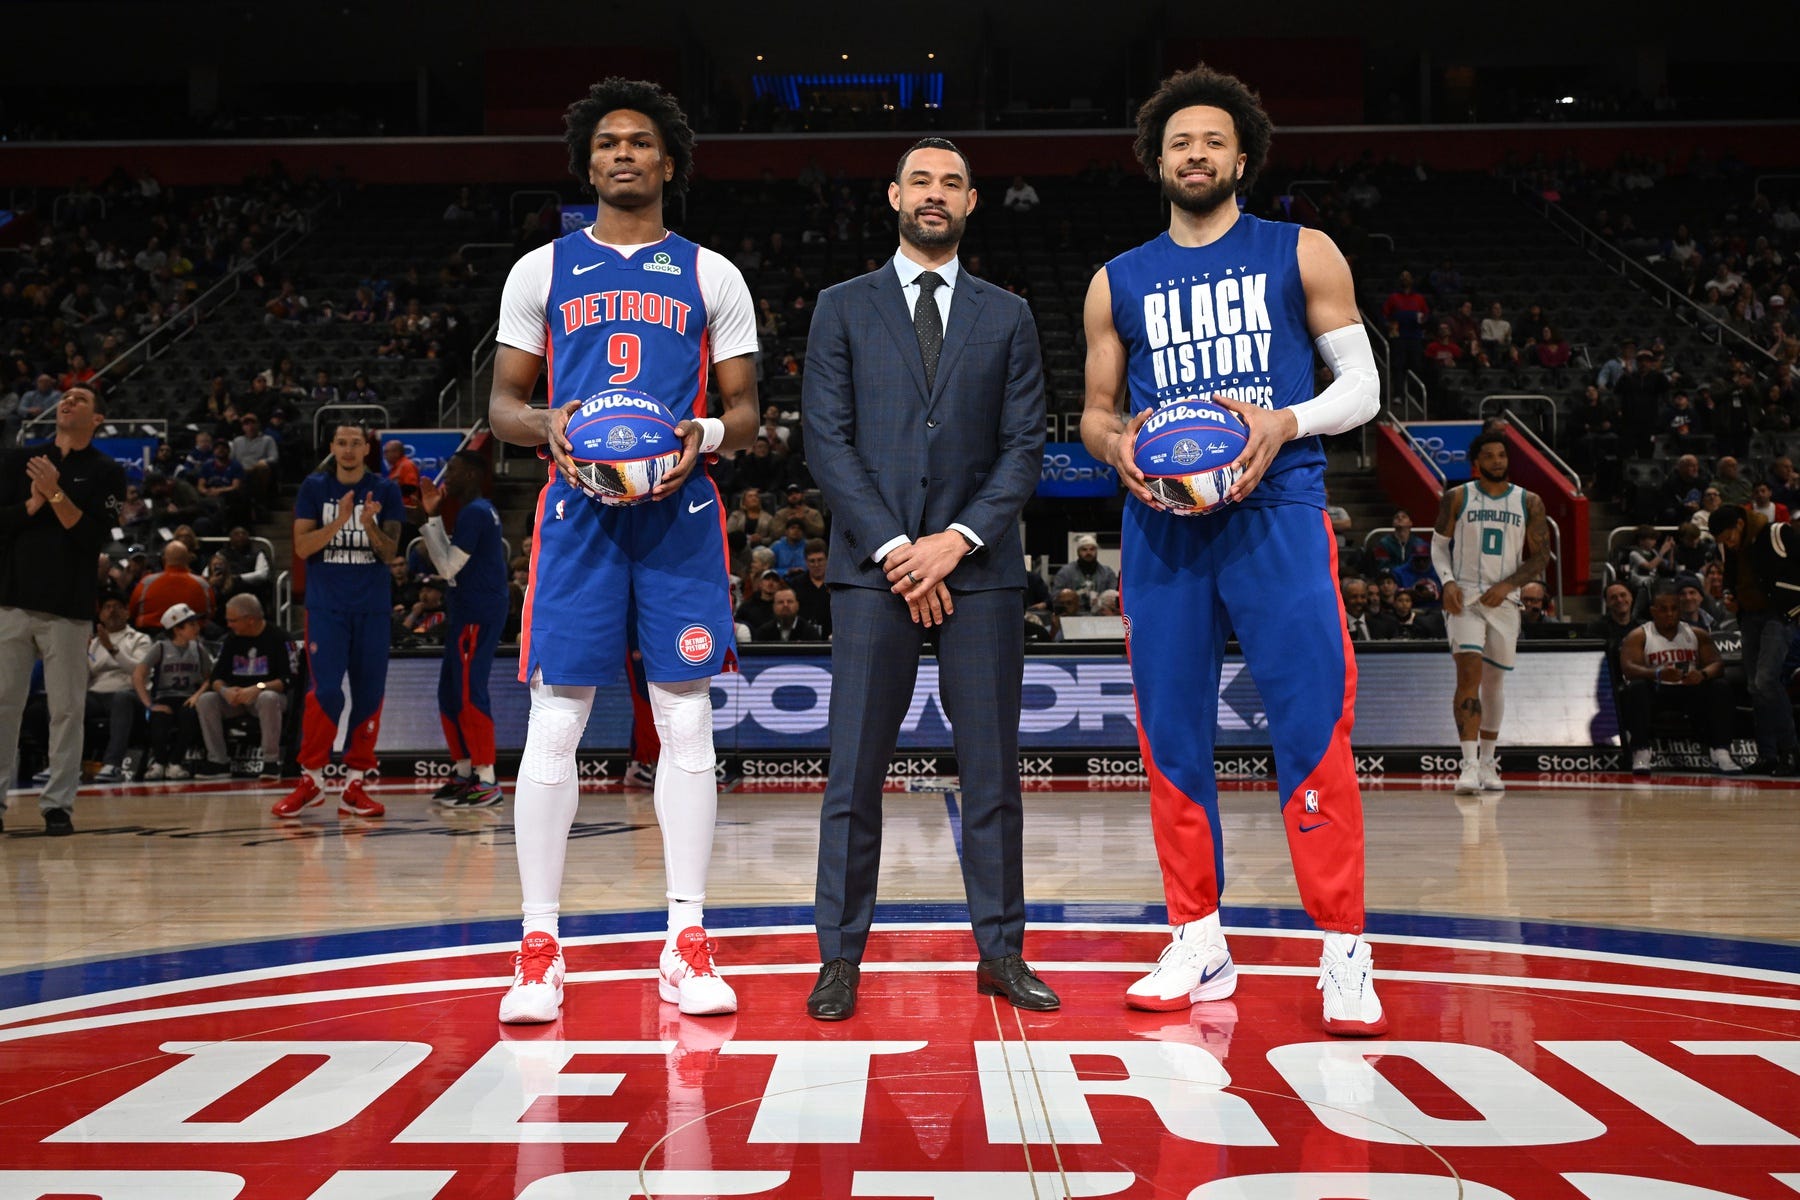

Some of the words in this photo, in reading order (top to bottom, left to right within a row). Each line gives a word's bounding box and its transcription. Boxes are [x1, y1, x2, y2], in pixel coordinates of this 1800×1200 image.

[645, 264, 680, 274] StockX
[1156, 273, 1210, 289] BUILT
[1226, 266, 1247, 276] BY
[559, 290, 692, 336] DETROIT
[1144, 273, 1272, 350] BLACK
[607, 333, 641, 385] 9
[1152, 333, 1272, 390] HISTORY
[1156, 378, 1239, 398] ELEVATED
[581, 394, 662, 417] Wilson
[1146, 406, 1226, 433] Wilson
[1467, 509, 1522, 527] CHARLOTTE
[1482, 528, 1504, 555] 0
[742, 759, 823, 774] StockX
[1214, 757, 1268, 774] ockX
[1537, 754, 1619, 771] StockX
